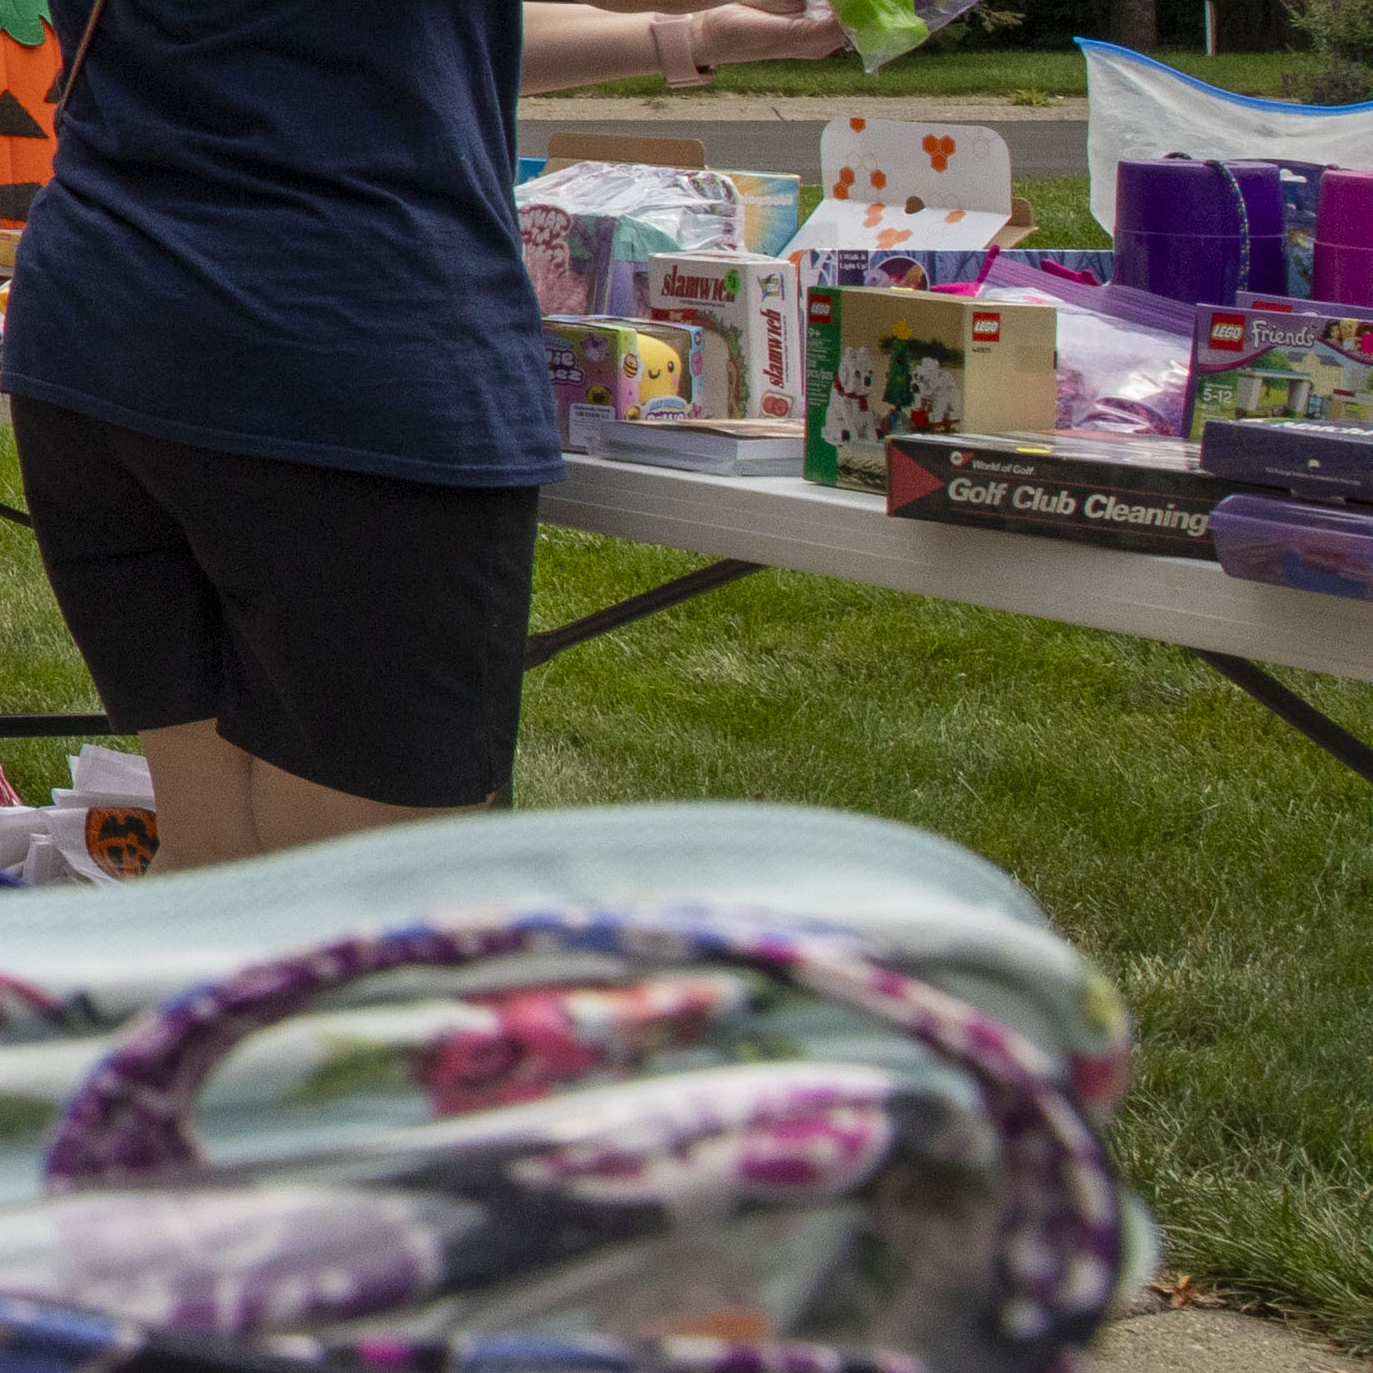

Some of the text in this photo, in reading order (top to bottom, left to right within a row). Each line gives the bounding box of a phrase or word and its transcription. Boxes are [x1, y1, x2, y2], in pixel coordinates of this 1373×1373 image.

[810, 302, 831, 315] LEGO
[974, 320, 999, 333] LEGO
[1212, 319, 1316, 348] LEGO Friends
[760, 308, 785, 389] slamwich
[1203, 388, 1233, 404] 5-12
[972, 460, 1035, 476] World of Golf
[948, 477, 1211, 537] Golf Club Cleaning
